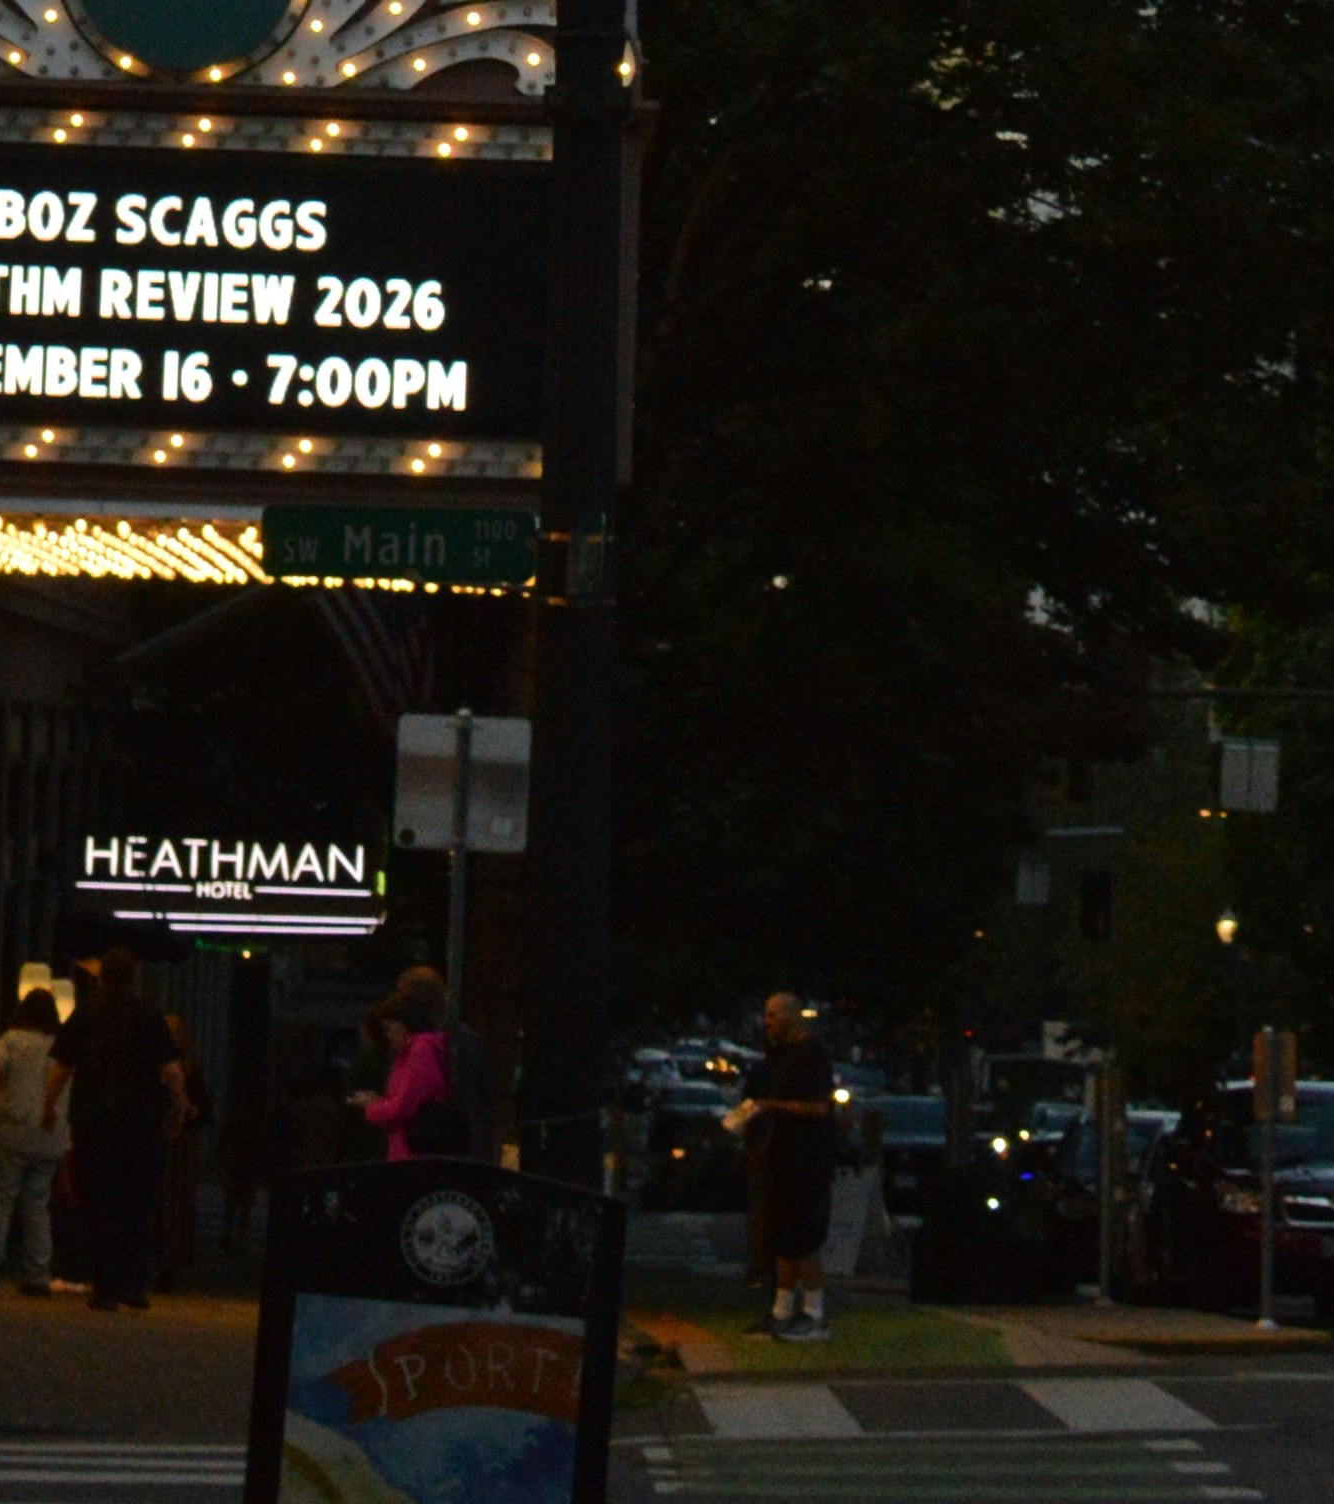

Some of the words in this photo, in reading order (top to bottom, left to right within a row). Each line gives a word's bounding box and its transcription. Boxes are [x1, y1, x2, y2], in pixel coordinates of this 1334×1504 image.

[115, 193, 328, 252] SCAGGS
[99, 267, 296, 326] REVIEW
[314, 275, 446, 332] 2026
[162, 349, 214, 403] 16
[266, 352, 467, 411] 7:00PM
[283, 539, 318, 564] SW
[341, 522, 447, 567] Main
[473, 519, 516, 541] 1100
[84, 835, 365, 884] HEATHMAN
[195, 880, 253, 901] HOTEL
